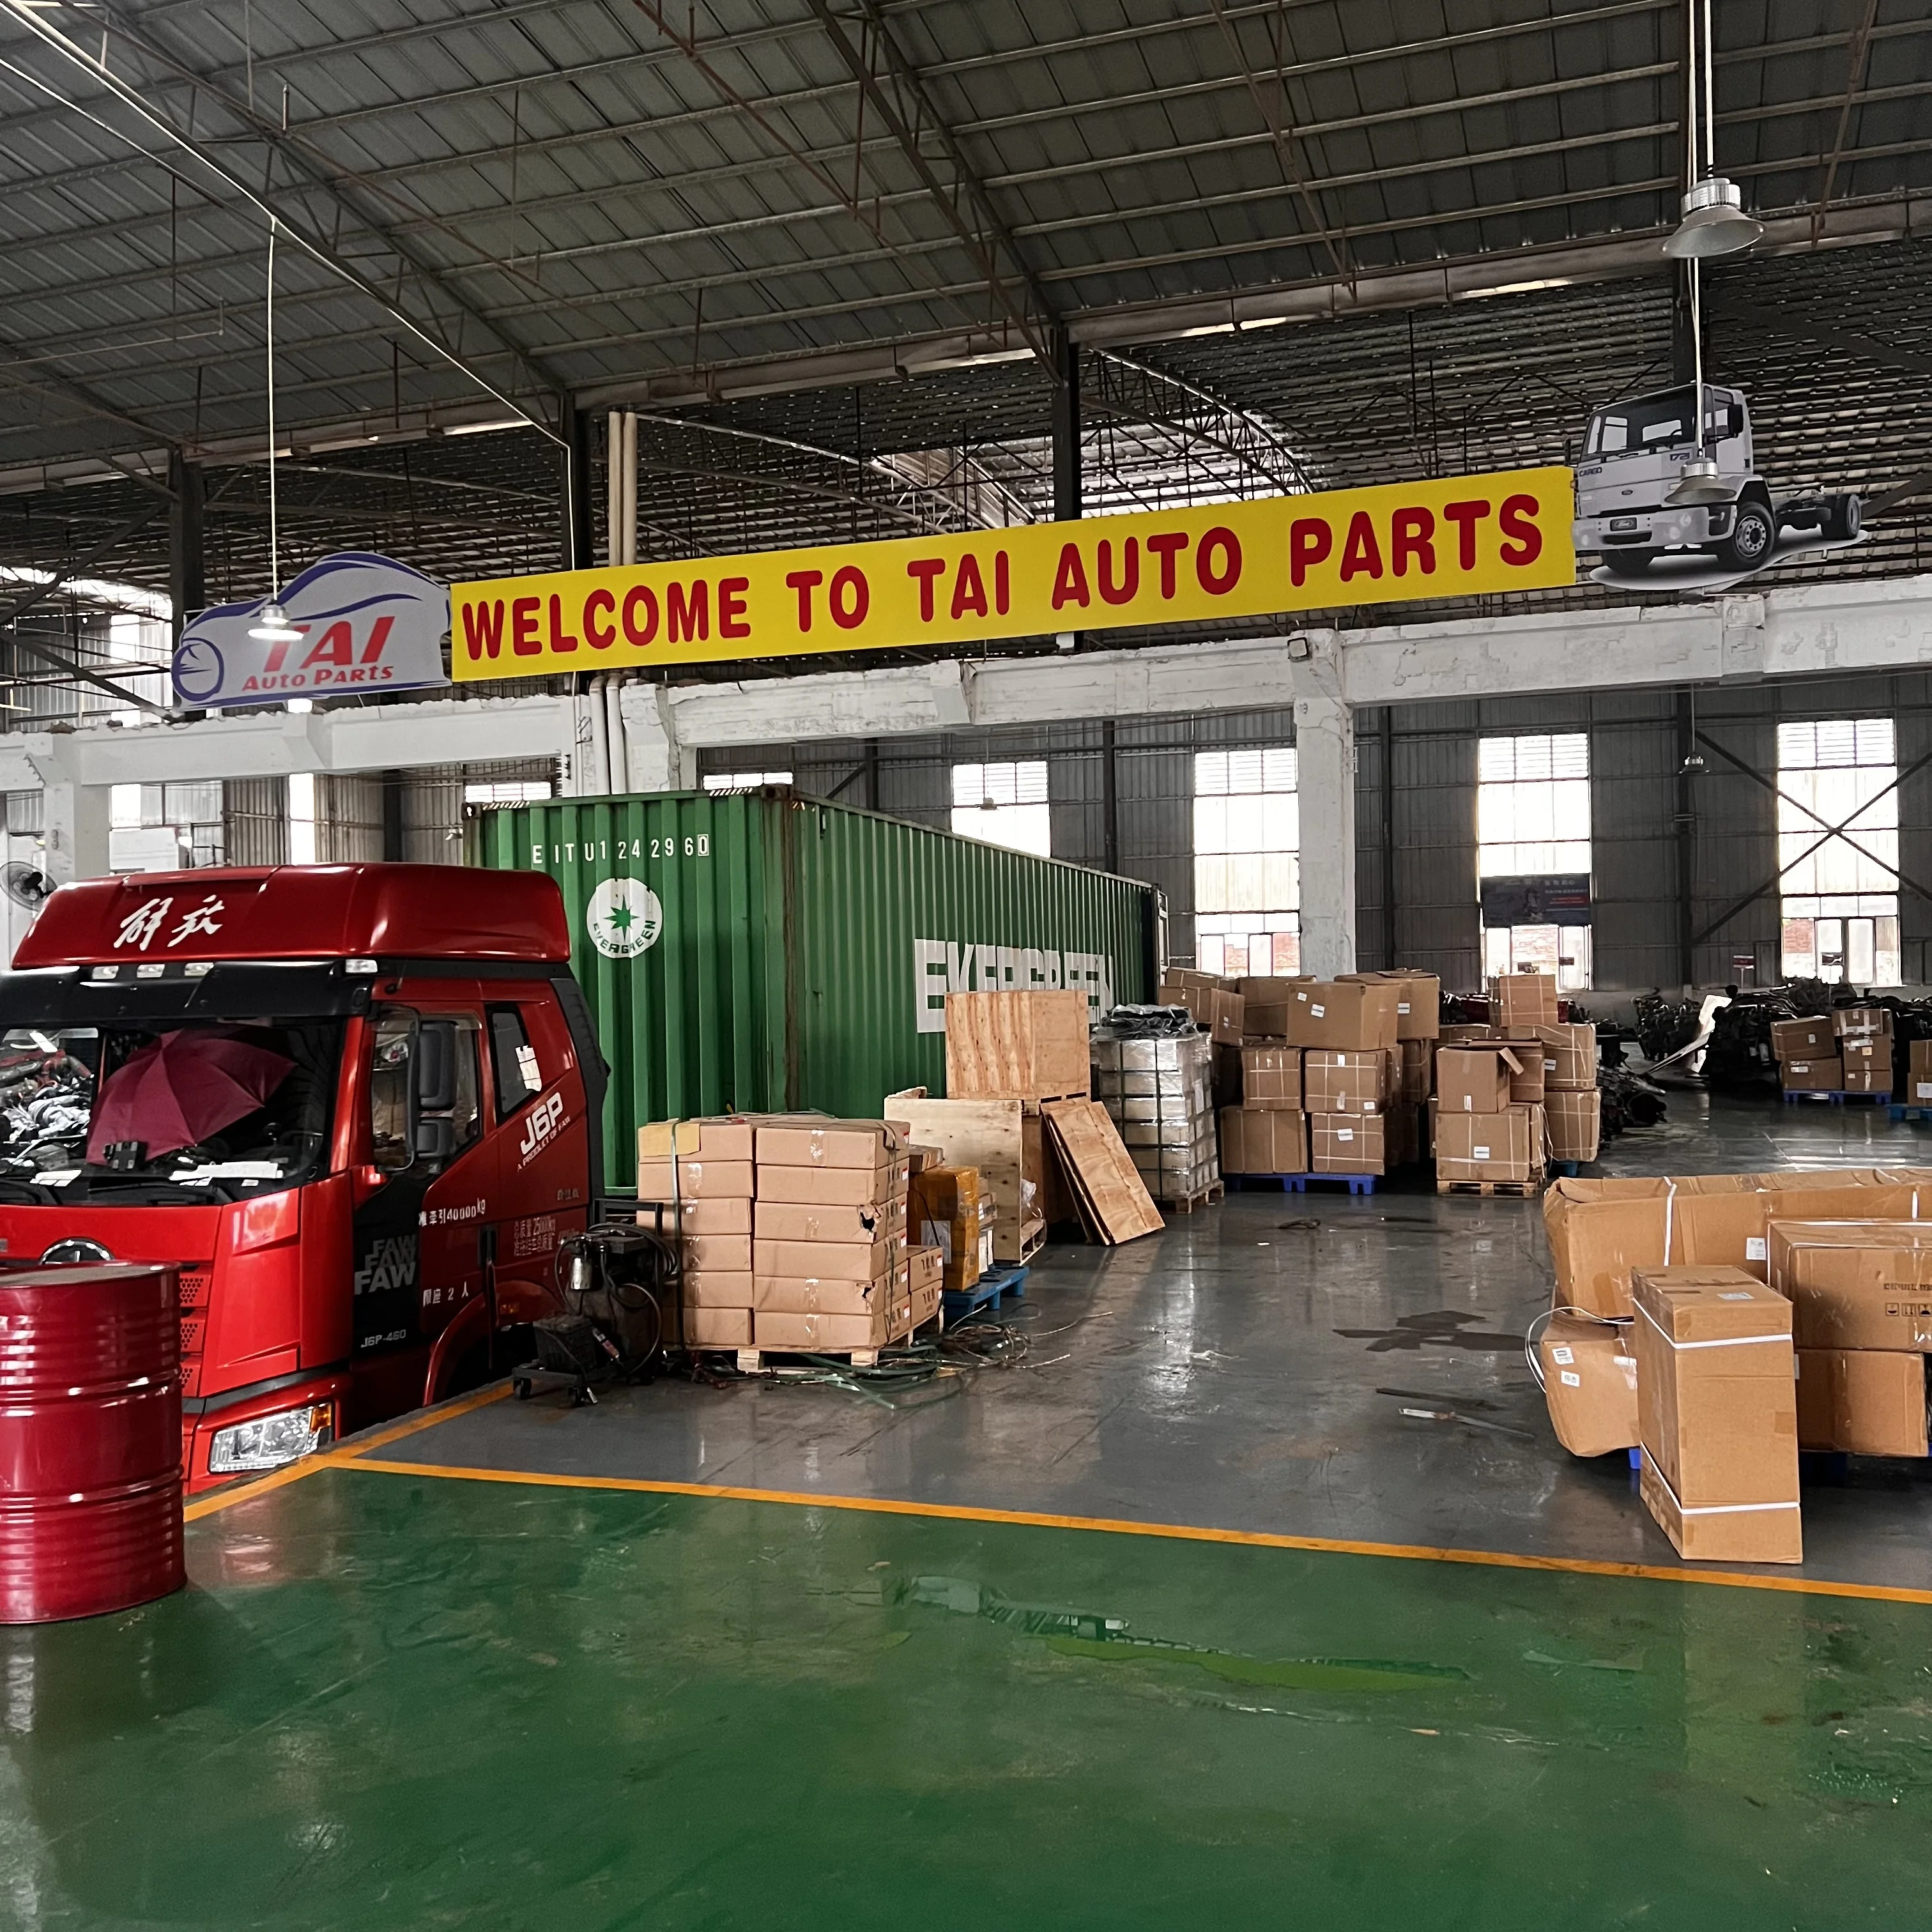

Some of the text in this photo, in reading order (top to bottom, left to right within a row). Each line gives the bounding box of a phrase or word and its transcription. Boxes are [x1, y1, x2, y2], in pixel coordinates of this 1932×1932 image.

[462, 493, 1542, 661] WELCOME TO TAI AUTO PARTS
[264, 615, 395, 673] TAI
[113, 894, 225, 951] 解放
[593, 919, 656, 954] EVERGREEN
[520, 1092, 564, 1155] J6P
[354, 1261, 416, 1296] FAW
